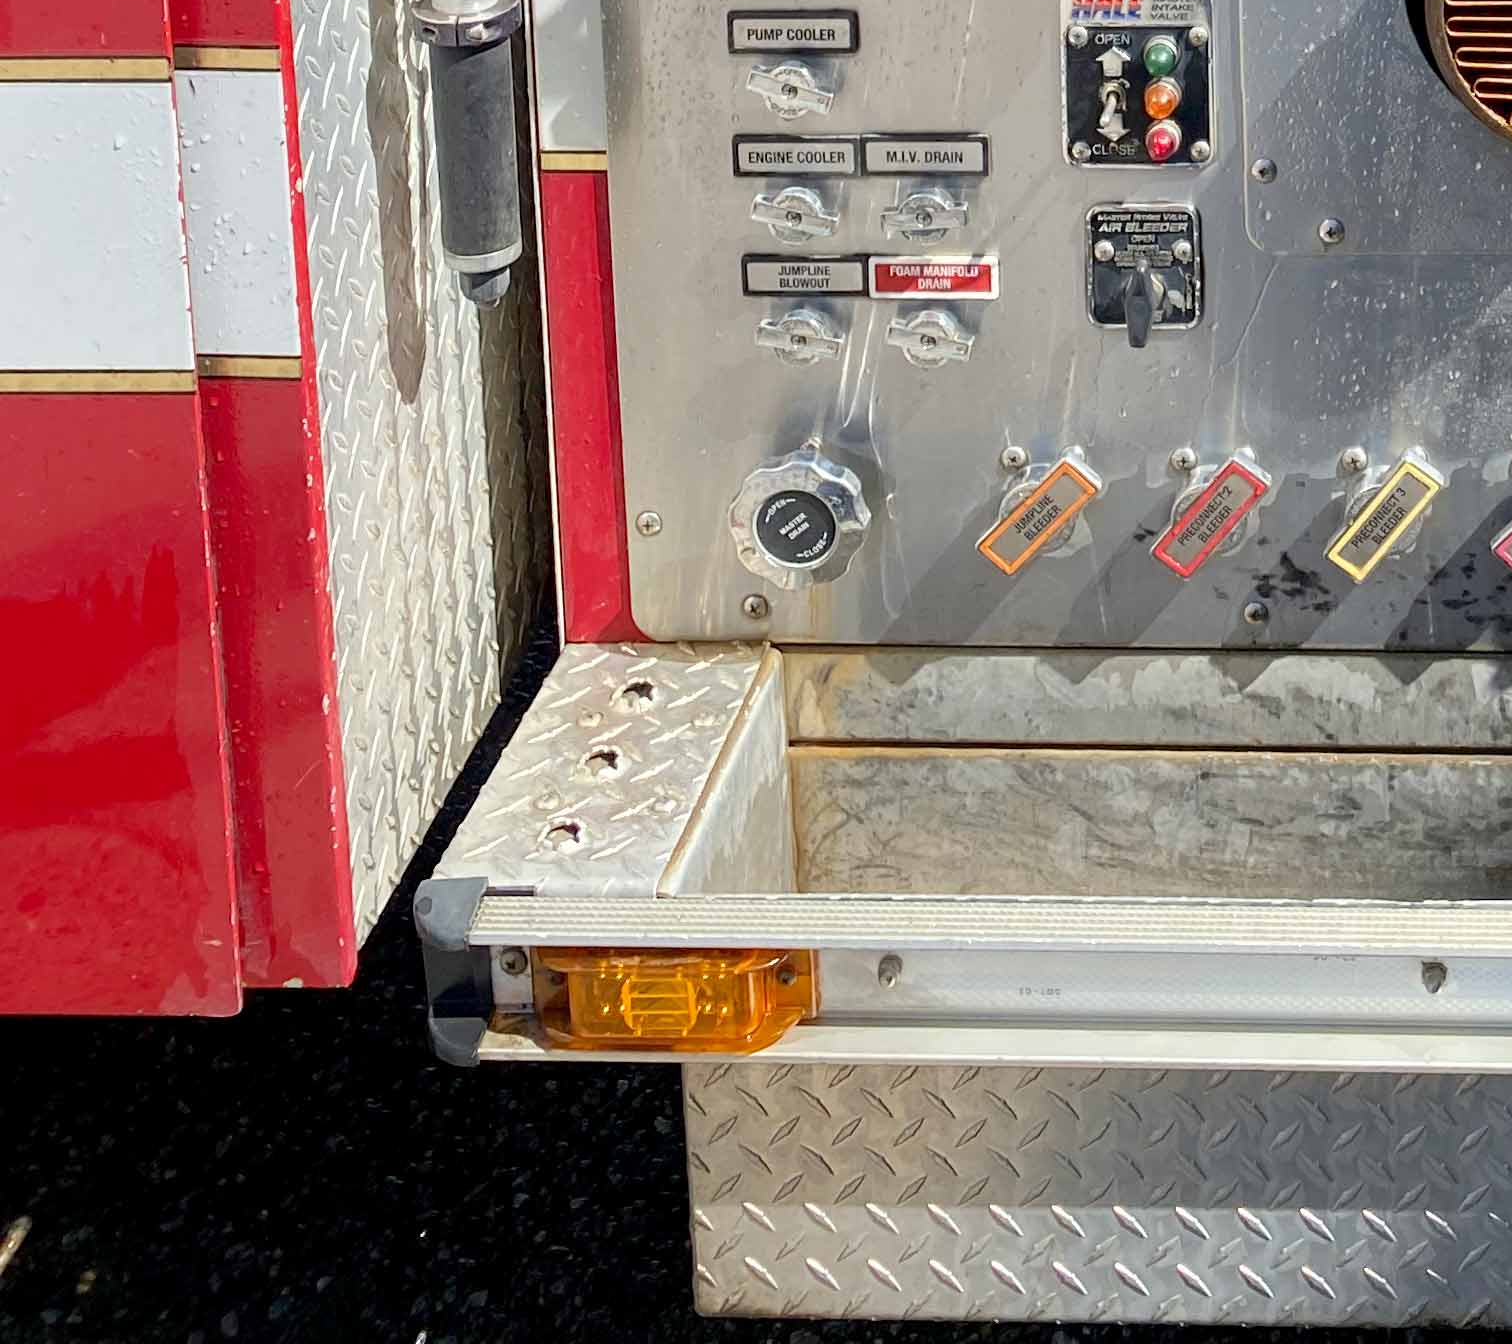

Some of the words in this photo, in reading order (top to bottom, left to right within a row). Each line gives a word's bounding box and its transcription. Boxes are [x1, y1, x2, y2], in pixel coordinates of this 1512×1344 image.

[747, 28, 783, 41] PUMP
[786, 28, 836, 41] COOLER
[1094, 33, 1130, 45] OPEN
[748, 151, 793, 163] ENGINE
[797, 151, 846, 163] COOLER
[886, 151, 921, 163] M.I.V.
[924, 151, 964, 163] DRAIN
[1092, 145, 1136, 156] CLOSE
[1098, 222, 1122, 233] AIR
[1124, 222, 1188, 233] BLEEDER
[777, 265, 831, 276] JUMPLINE
[890, 265, 921, 277] FOAM
[923, 265, 979, 277] MANIFOLD
[779, 277, 831, 289] BLOWOUT
[918, 277, 952, 289] DRAIN
[1013, 494, 1055, 534] JUMPLINE
[1177, 492, 1222, 546] PRECONNECT
[779, 513, 808, 536] MASTER
[1024, 504, 1063, 541] BLEEDER
[1199, 504, 1233, 544] BLEEDER
[1351, 495, 1400, 549] PRECONNECT
[1374, 505, 1408, 545] BLEEDER
[788, 523, 810, 540] DRAIN
[804, 539, 827, 558] CLOSE
